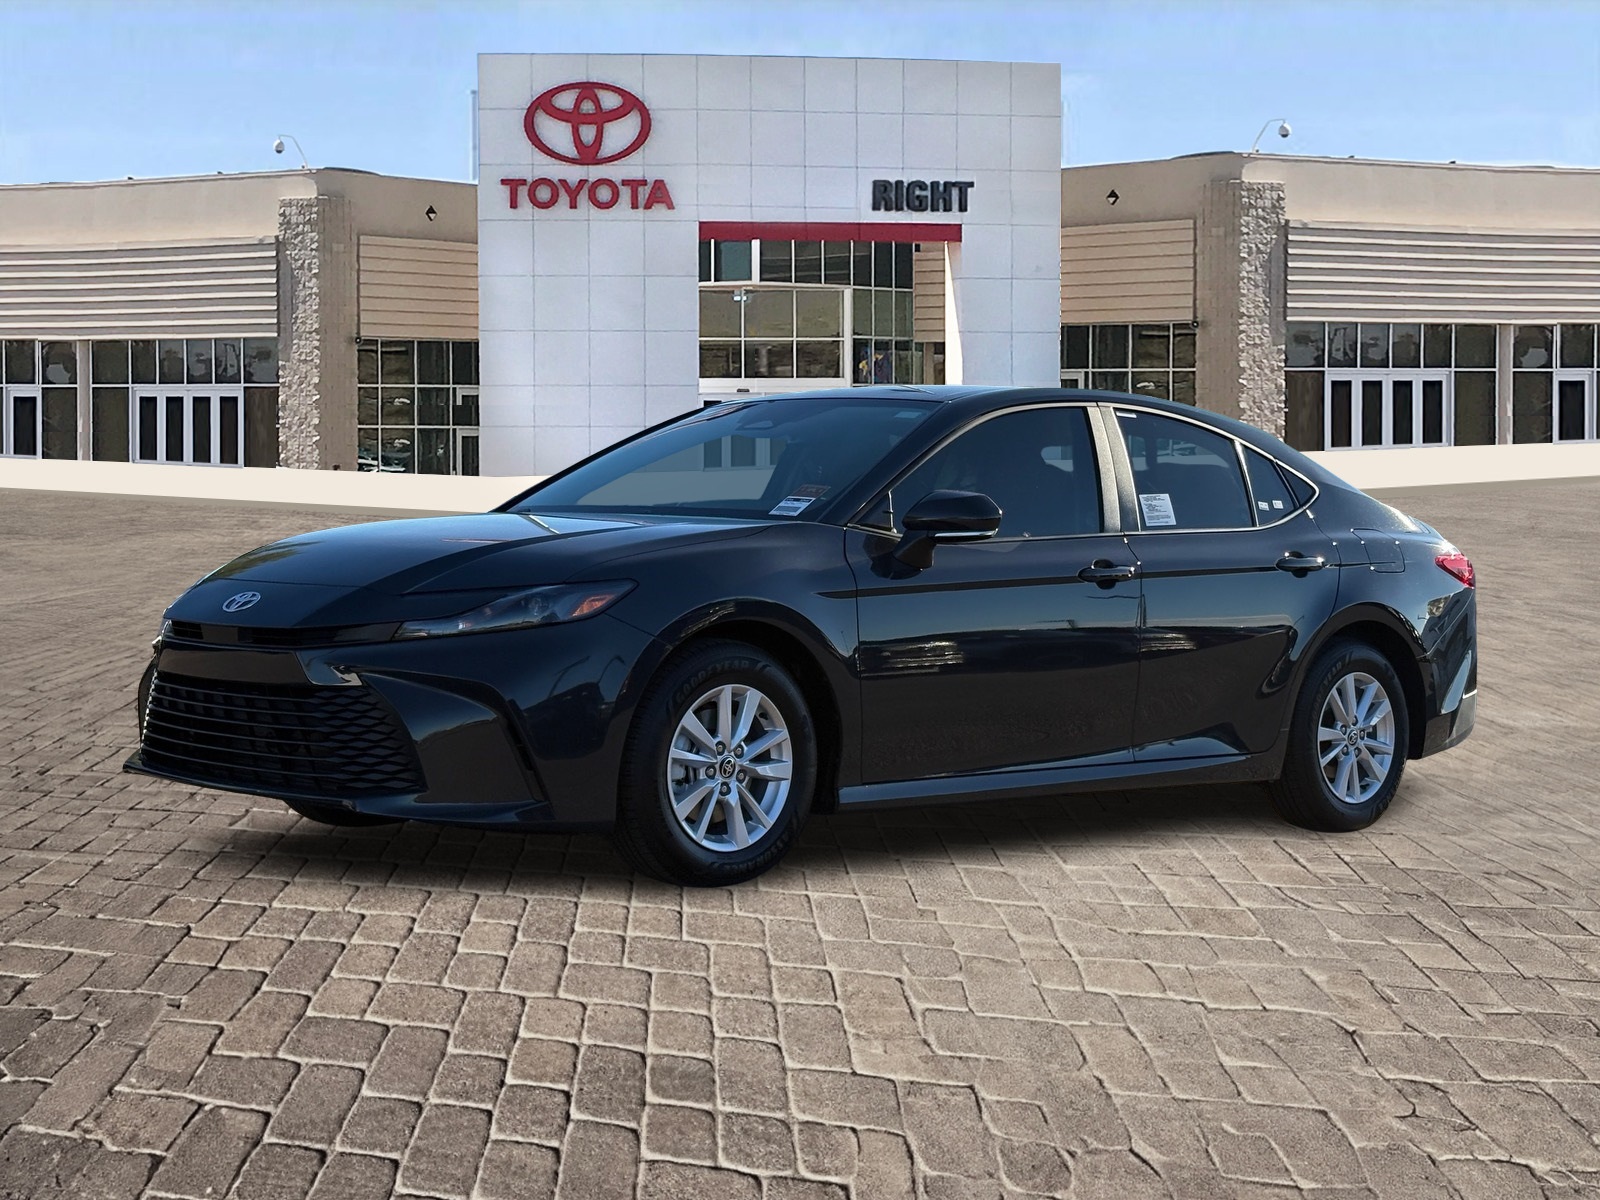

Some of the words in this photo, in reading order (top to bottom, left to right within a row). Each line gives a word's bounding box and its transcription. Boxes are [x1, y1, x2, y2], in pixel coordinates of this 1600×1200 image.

[500, 177, 676, 210] TOYOTA
[872, 179, 975, 212] RIGHT
[675, 659, 750, 704] GOODYEAR
